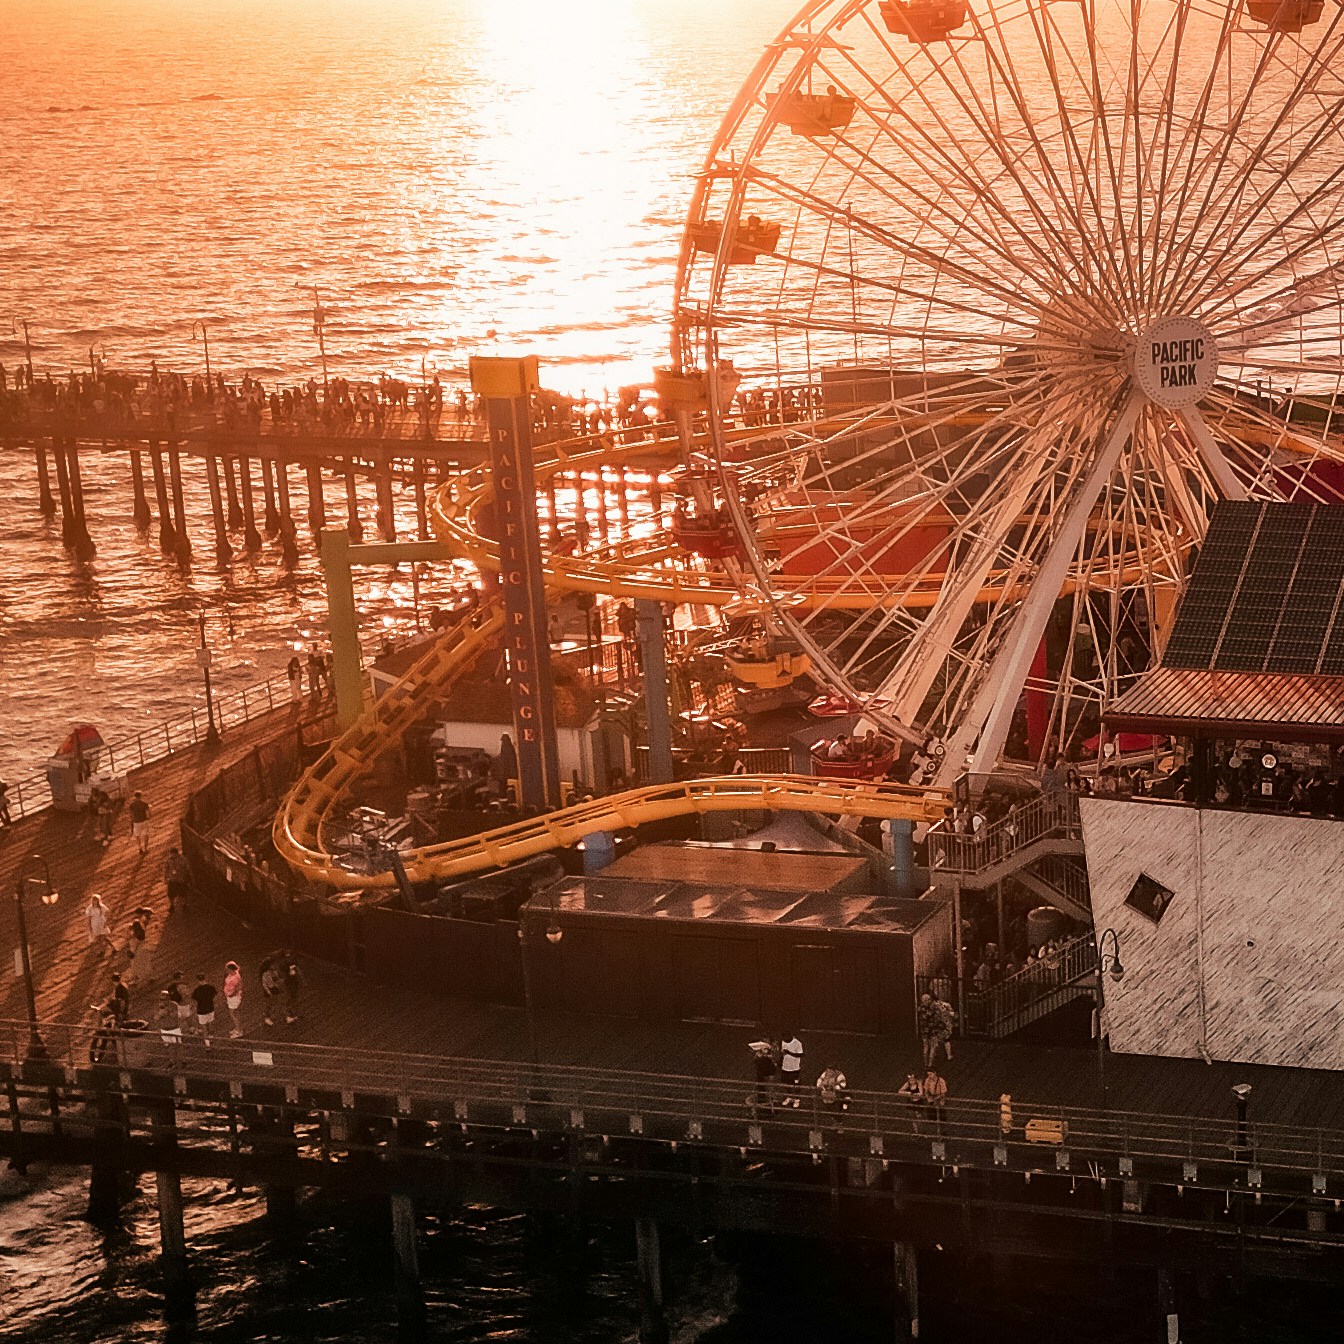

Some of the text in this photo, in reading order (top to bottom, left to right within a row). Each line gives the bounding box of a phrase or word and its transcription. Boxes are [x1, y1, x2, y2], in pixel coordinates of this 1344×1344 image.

[1152, 338, 1204, 365] PACIFIC
[1160, 364, 1197, 388] PARK
[498, 429, 534, 742] PACIFIC PLUNGE
